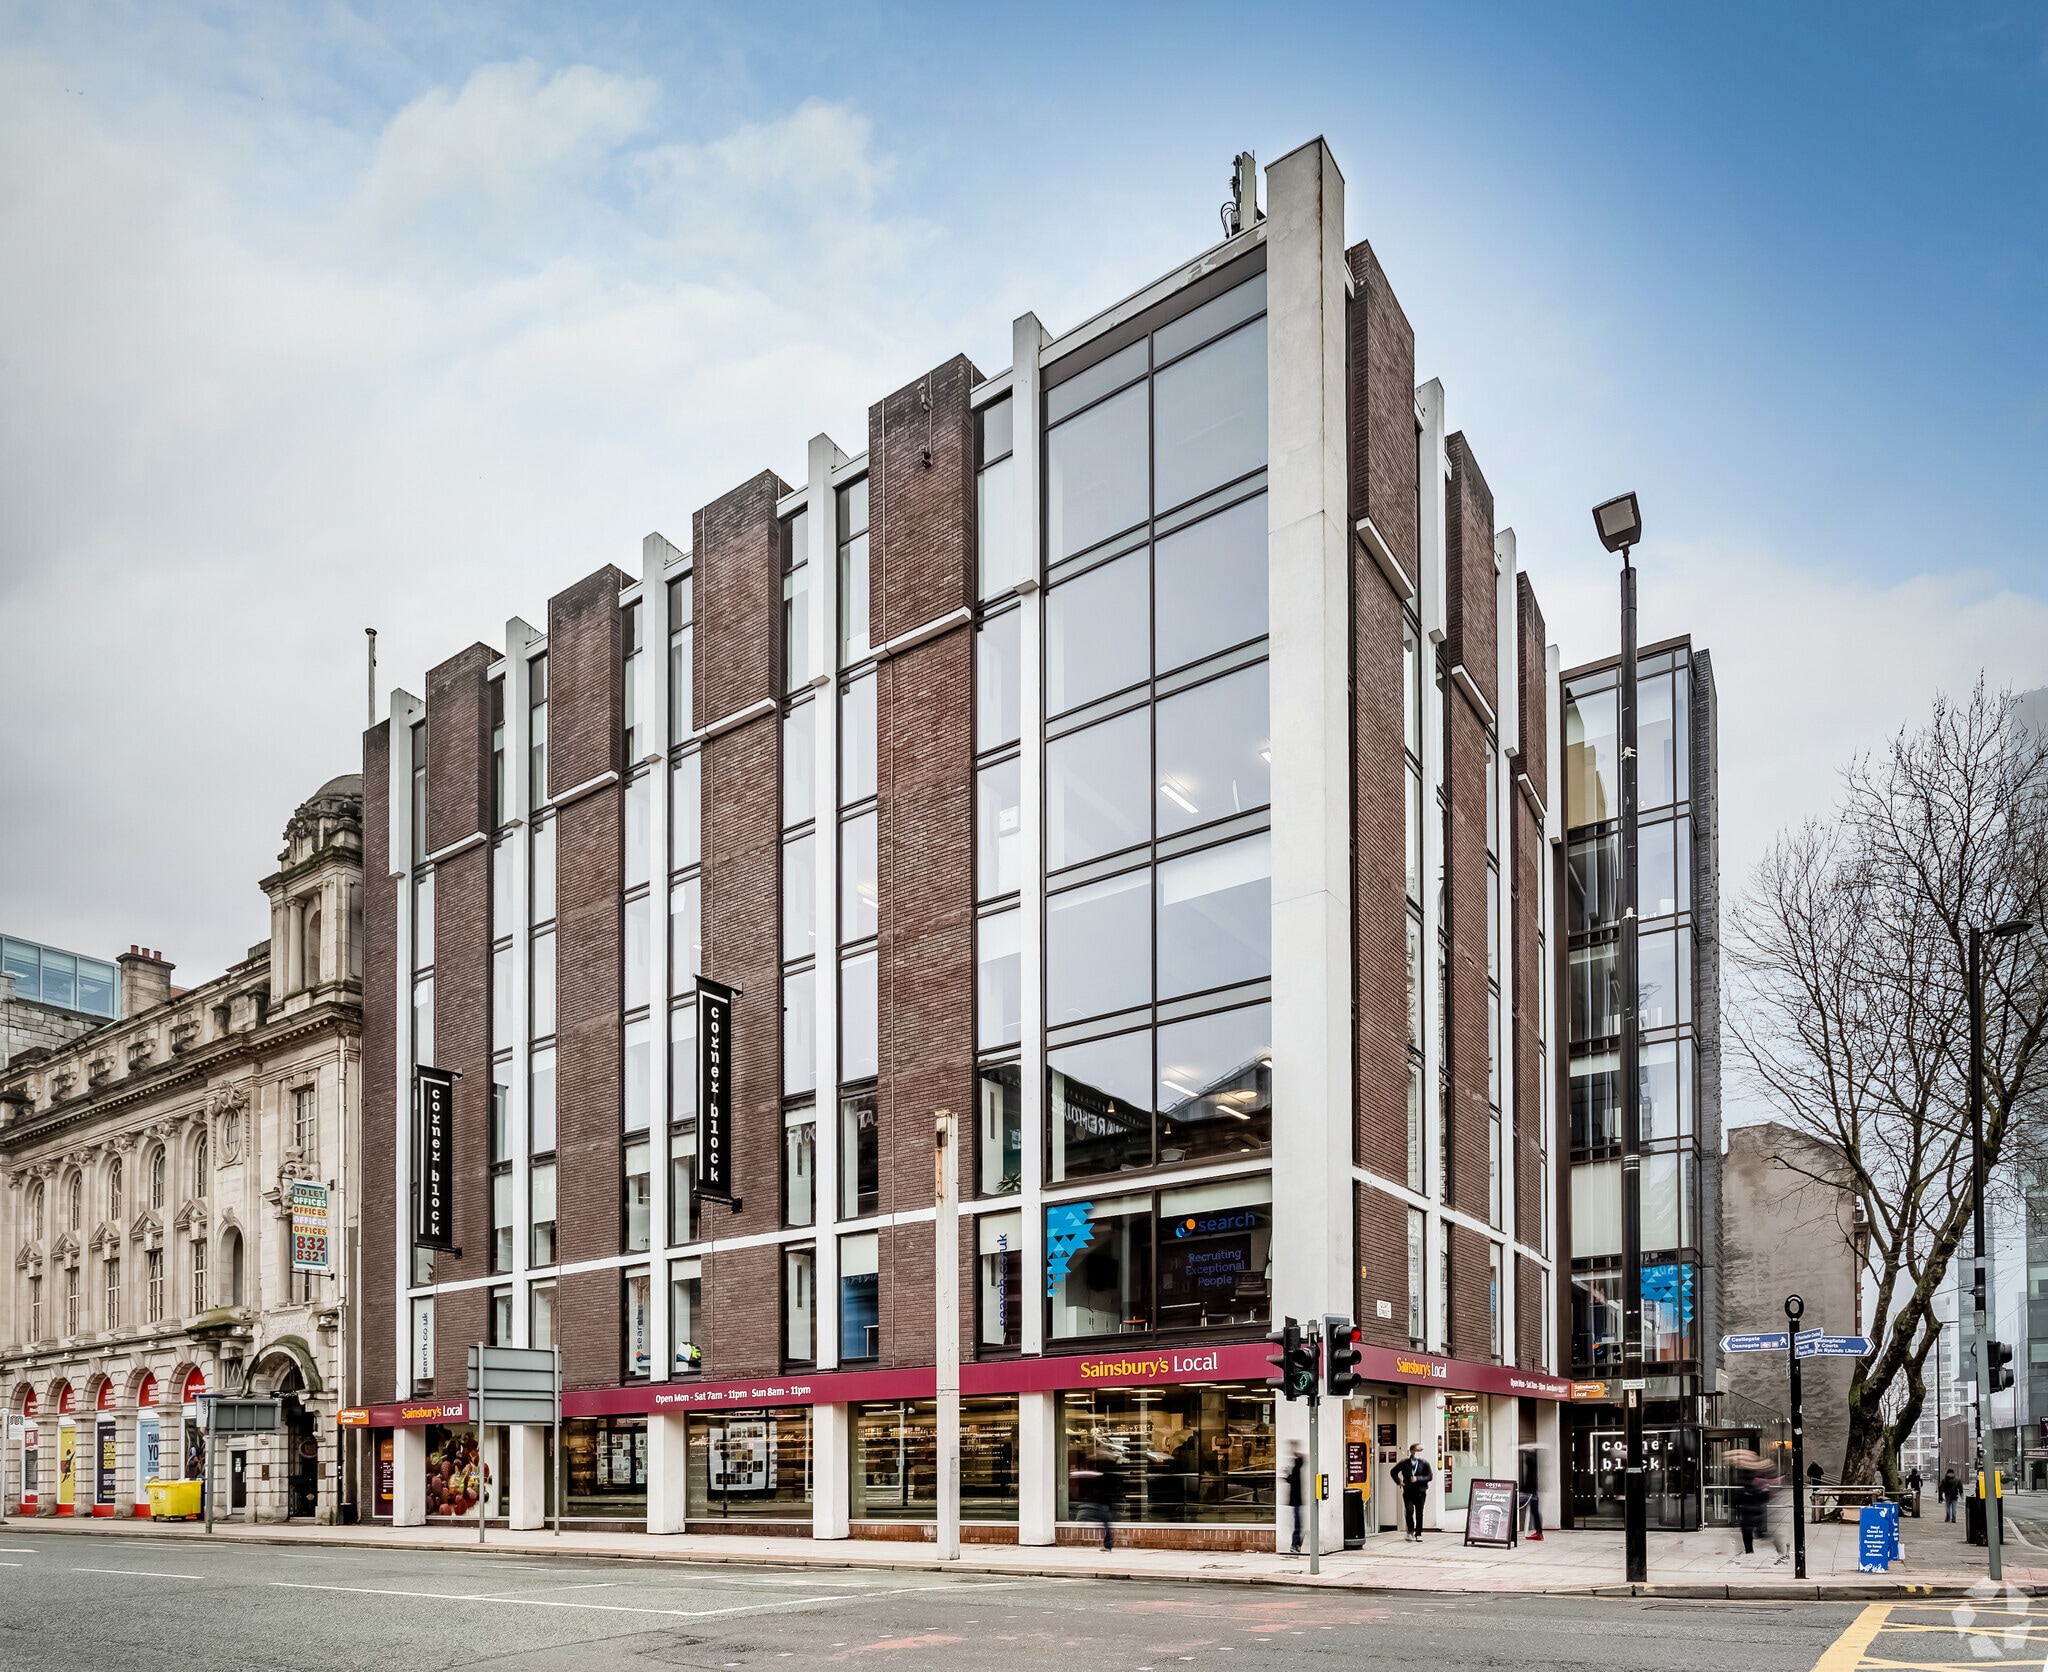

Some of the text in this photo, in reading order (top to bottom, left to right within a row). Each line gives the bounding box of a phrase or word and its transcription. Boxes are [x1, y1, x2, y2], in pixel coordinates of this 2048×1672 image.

[710, 1006, 720, 1182] corner block
[432, 1089, 440, 1235] corner block
[296, 1188, 324, 1198] TO LET
[293, 1196, 326, 1208] OFFICES
[294, 1206, 326, 1216] OFFICES
[294, 1216, 326, 1226] OFFICES
[1198, 1212, 1256, 1232] search
[294, 1226, 327, 1236] OFFICES
[296, 1236, 325, 1252] 832
[296, 1250, 326, 1262] 8321
[1188, 1250, 1242, 1264] Recruiting
[1186, 1260, 1245, 1276] Exceptional
[996, 1233, 1008, 1326] search.co.uk
[1198, 1275, 1232, 1287] People
[1080, 1352, 1218, 1378] Sainsbury's Local
[1396, 1356, 1447, 1379] Sainsbury's Local
[655, 1394, 673, 1405] Open
[674, 1393, 689, 1402] Mon
[694, 1392, 706, 1401] Sat
[707, 1391, 722, 1400] 7am
[728, 1390, 747, 1400] 11pm
[752, 1388, 766, 1398] Sun
[768, 1387, 784, 1396] 8am
[790, 1386, 811, 1397] 11pm
[402, 1404, 462, 1420] Sainsbury's Local
[148, 1444, 159, 1460] YO
[1603, 1457, 1660, 1470] blck
